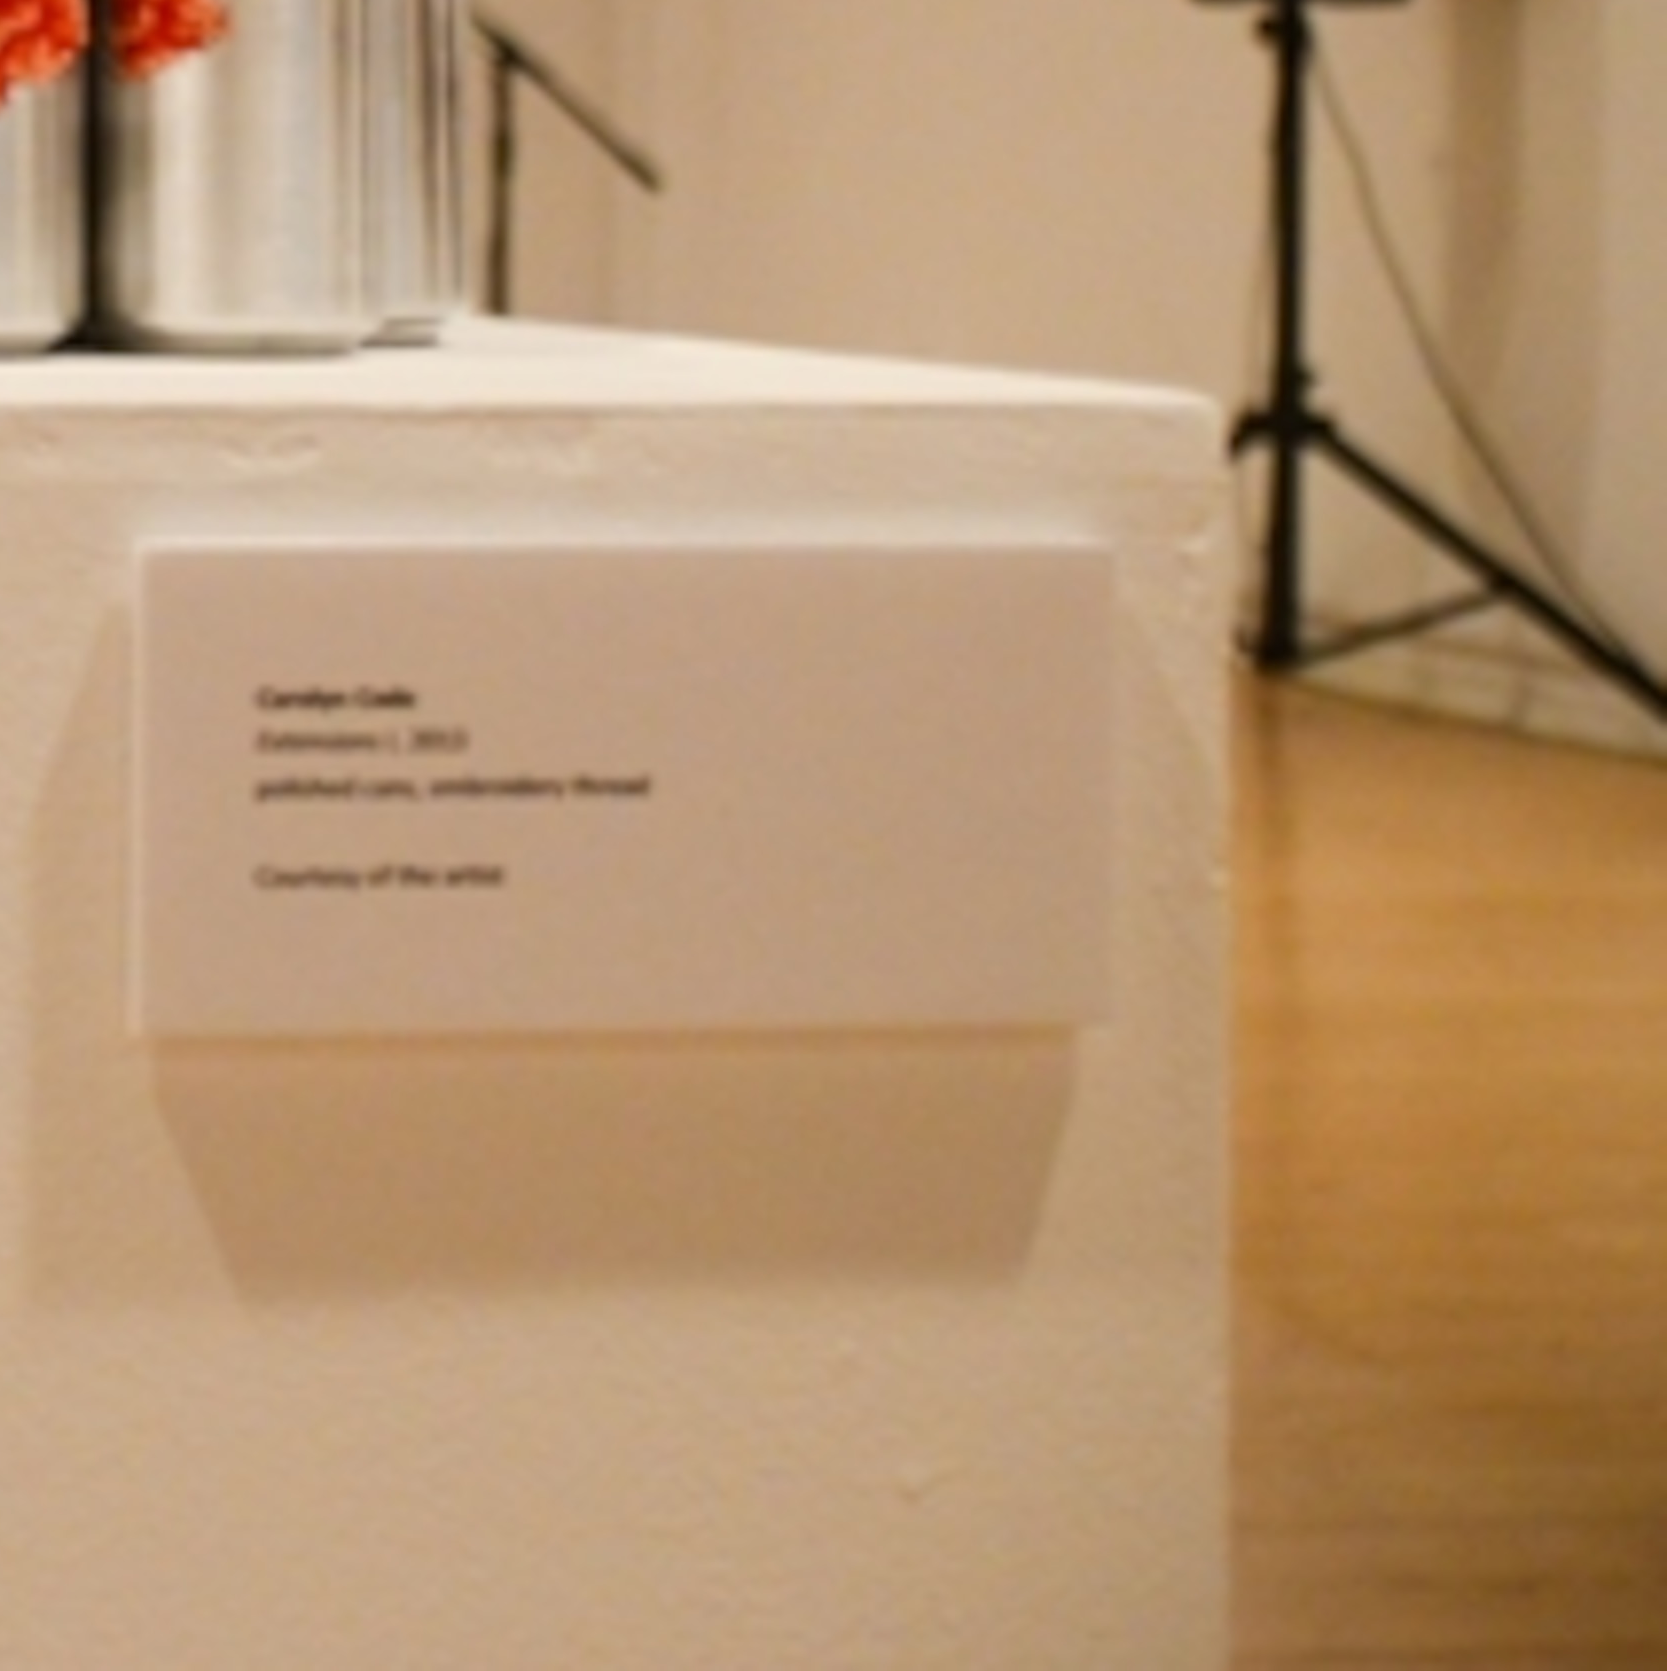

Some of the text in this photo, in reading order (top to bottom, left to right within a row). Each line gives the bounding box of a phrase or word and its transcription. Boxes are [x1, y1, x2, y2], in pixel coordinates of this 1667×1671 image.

[258, 772, 359, 803] polished
[428, 772, 569, 803] embroidery
[571, 772, 652, 798] thread
[257, 862, 506, 893] Courtesy of the artist
